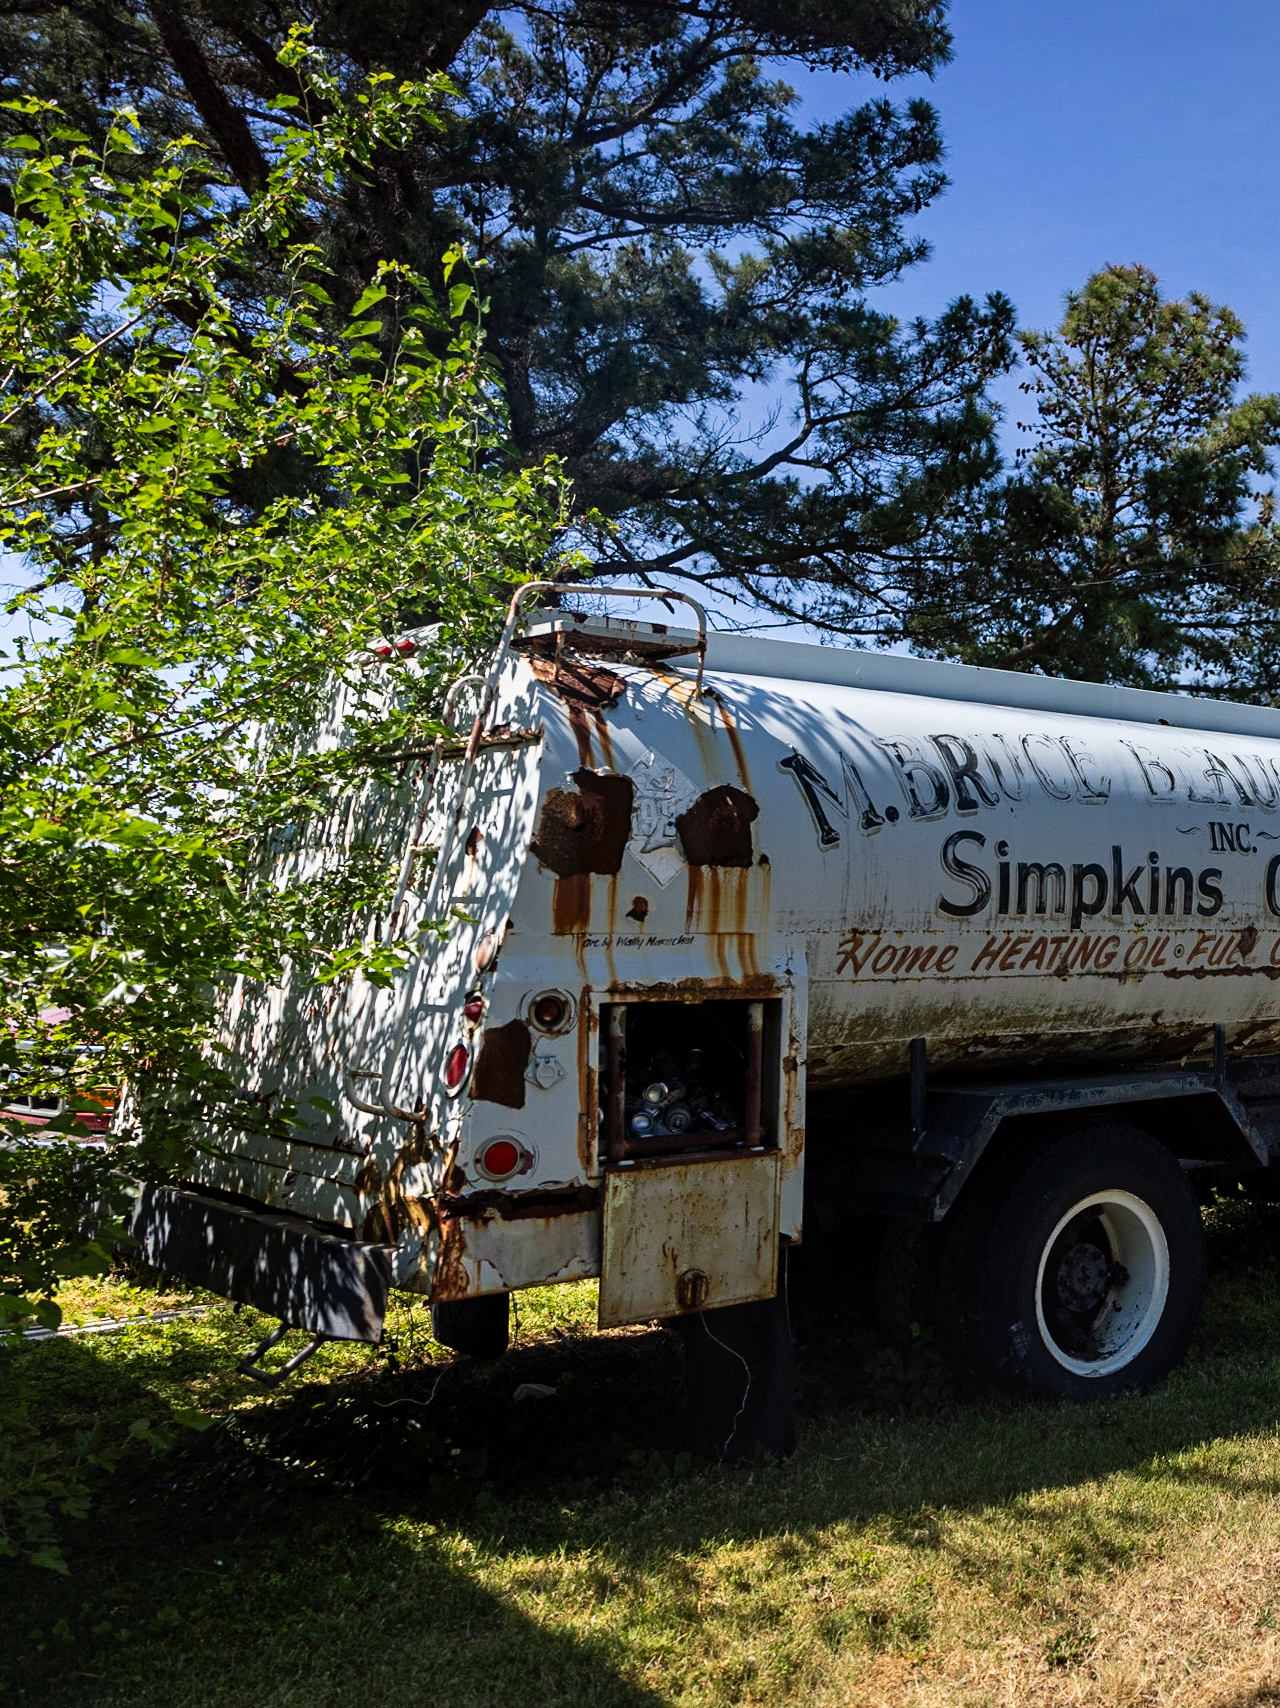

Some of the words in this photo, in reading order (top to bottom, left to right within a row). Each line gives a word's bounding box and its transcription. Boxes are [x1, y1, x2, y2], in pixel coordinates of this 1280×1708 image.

[1208, 821, 1257, 853] INC.
[937, 829, 1224, 929] Simpkins
[836, 935, 959, 977] Home
[970, 934, 1120, 970] HEATING
[1123, 935, 1170, 970] OIL
